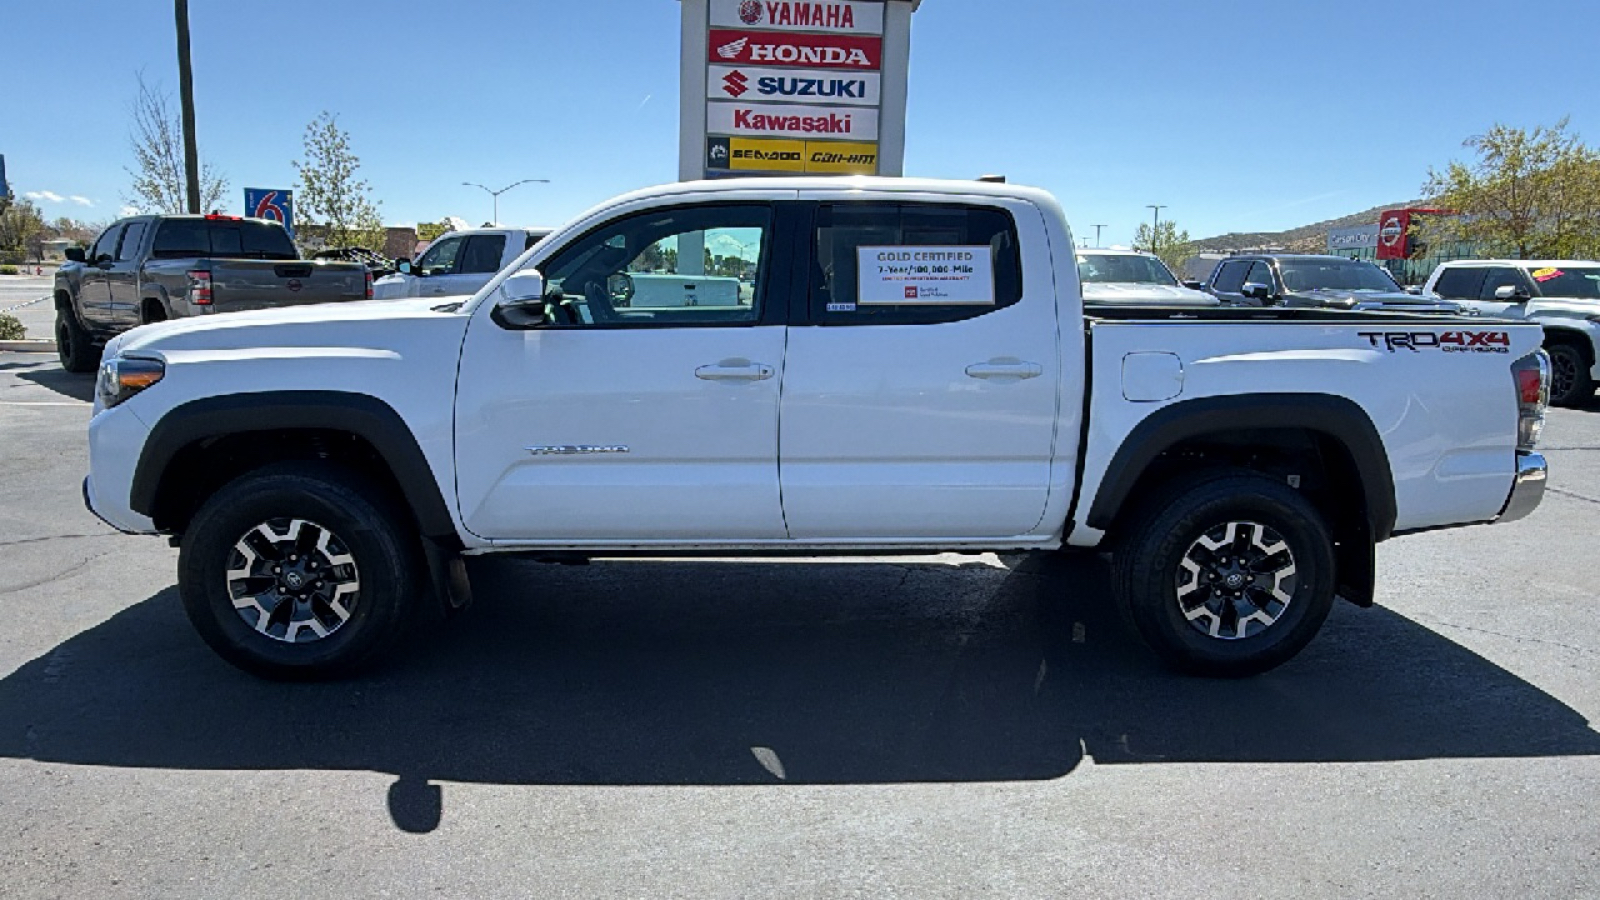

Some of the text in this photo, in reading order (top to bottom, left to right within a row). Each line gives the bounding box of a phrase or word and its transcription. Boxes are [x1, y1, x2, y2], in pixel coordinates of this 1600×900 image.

[767, 2, 854, 28] YAMAHA
[750, 44, 871, 66] HONDA
[758, 77, 866, 98] SUZUKI
[734, 109, 851, 133] Kawasaki
[877, 252, 973, 261] GOLD CERTIFIED
